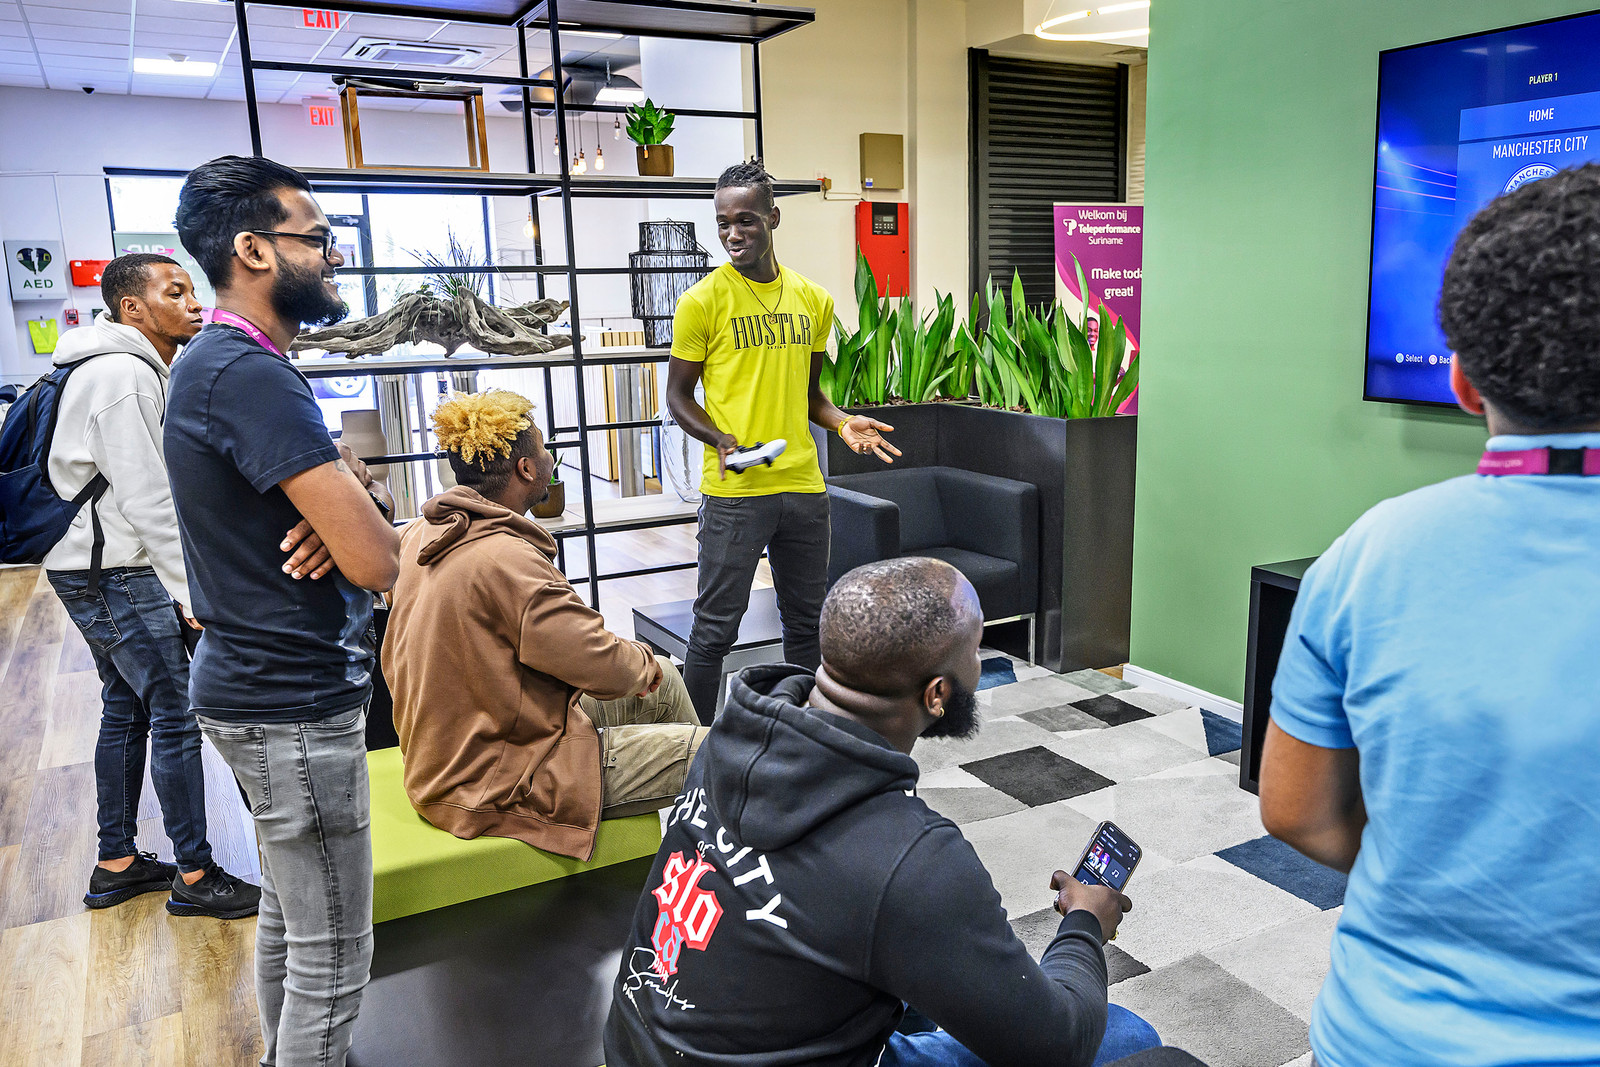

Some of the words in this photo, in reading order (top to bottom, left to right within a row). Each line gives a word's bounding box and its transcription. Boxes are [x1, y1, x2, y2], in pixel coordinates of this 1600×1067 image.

[1528, 73, 1553, 85] PLAYER
[1554, 72, 1558, 81] 1
[309, 104, 335, 126] EXIT
[1528, 107, 1555, 122] HOME
[1492, 138, 1562, 159] MANCHESTER
[1564, 135, 1589, 152] CITY
[1507, 168, 1556, 192] MANCHES
[1078, 209, 1115, 220] Welkom
[1116, 209, 1128, 222] bij
[1078, 223, 1141, 236] Teleperformance
[1088, 236, 1124, 245] Suriname
[1091, 267, 1122, 280] Make
[23, 279, 54, 289] AED
[1104, 285, 1134, 300] great!
[730, 313, 812, 350] HUSTLR
[1405, 354, 1423, 363] Select
[668, 787, 708, 830] THE
[716, 826, 788, 929] CITY
